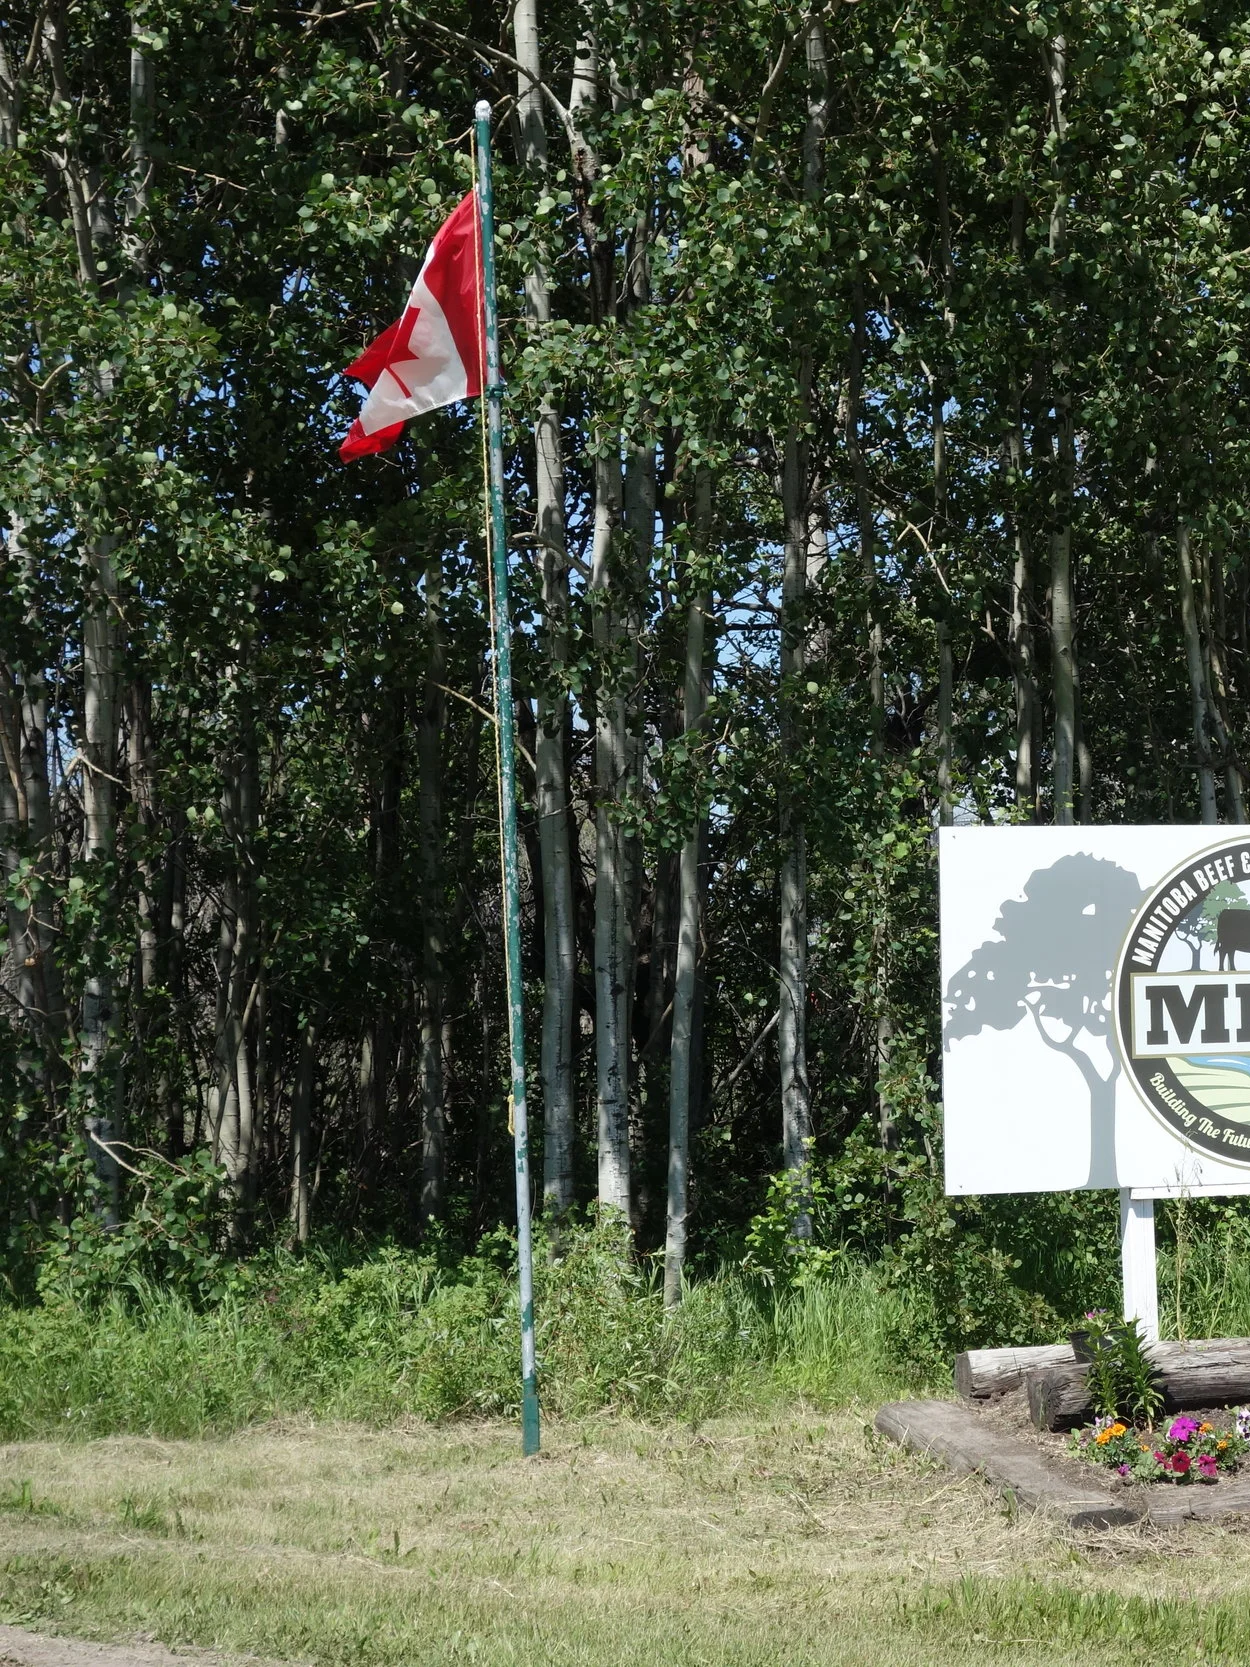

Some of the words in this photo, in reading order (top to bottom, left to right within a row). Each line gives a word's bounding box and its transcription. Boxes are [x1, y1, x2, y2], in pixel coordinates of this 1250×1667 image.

[1131, 880, 1198, 967] MANITOBA
[1193, 855, 1235, 892] BEEF
[1149, 1072, 1198, 1127] Building
[1198, 1117, 1221, 1139] The
